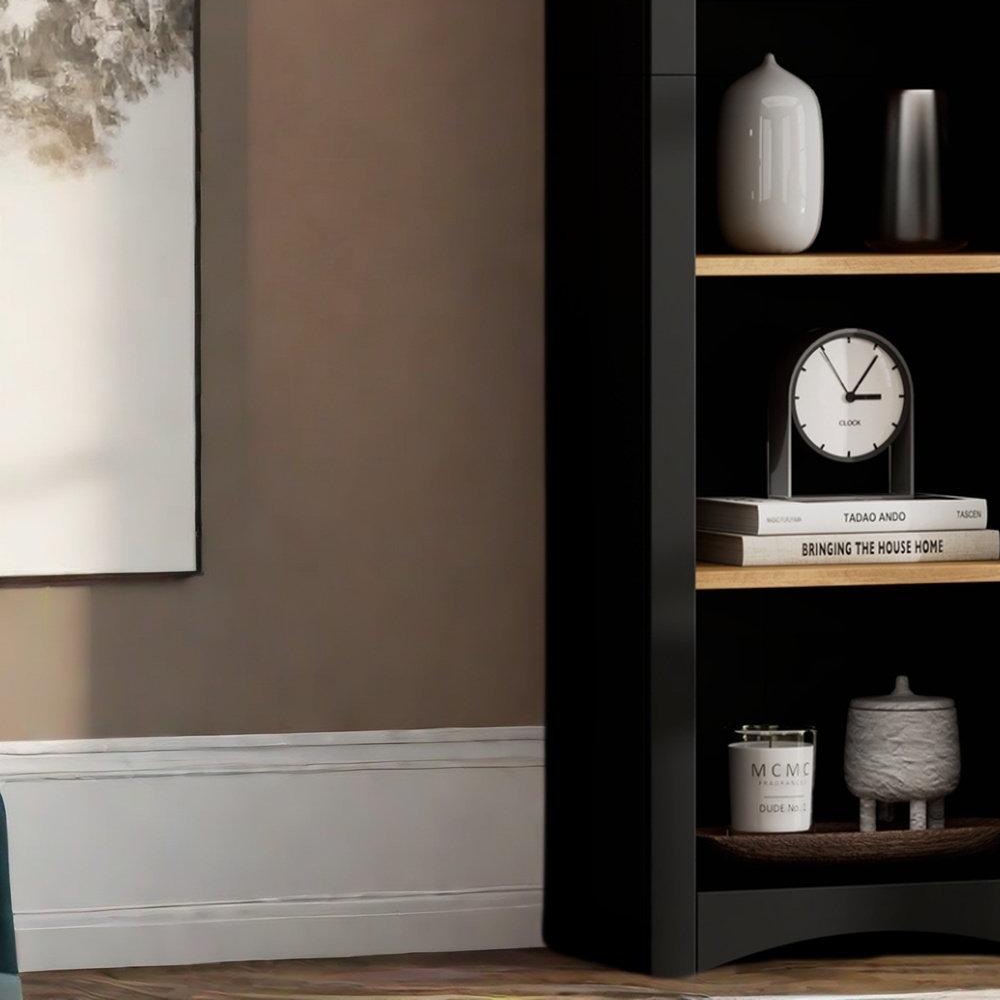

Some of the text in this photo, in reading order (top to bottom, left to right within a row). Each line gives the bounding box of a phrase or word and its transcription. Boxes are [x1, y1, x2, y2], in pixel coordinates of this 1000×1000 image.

[838, 419, 861, 427] CLOCK
[843, 511, 906, 523] TADAO ANDO
[801, 538, 944, 557] BRINGING THE HOUSE HOME
[751, 762, 810, 778] MCMC
[759, 803, 785, 813] DUDE
